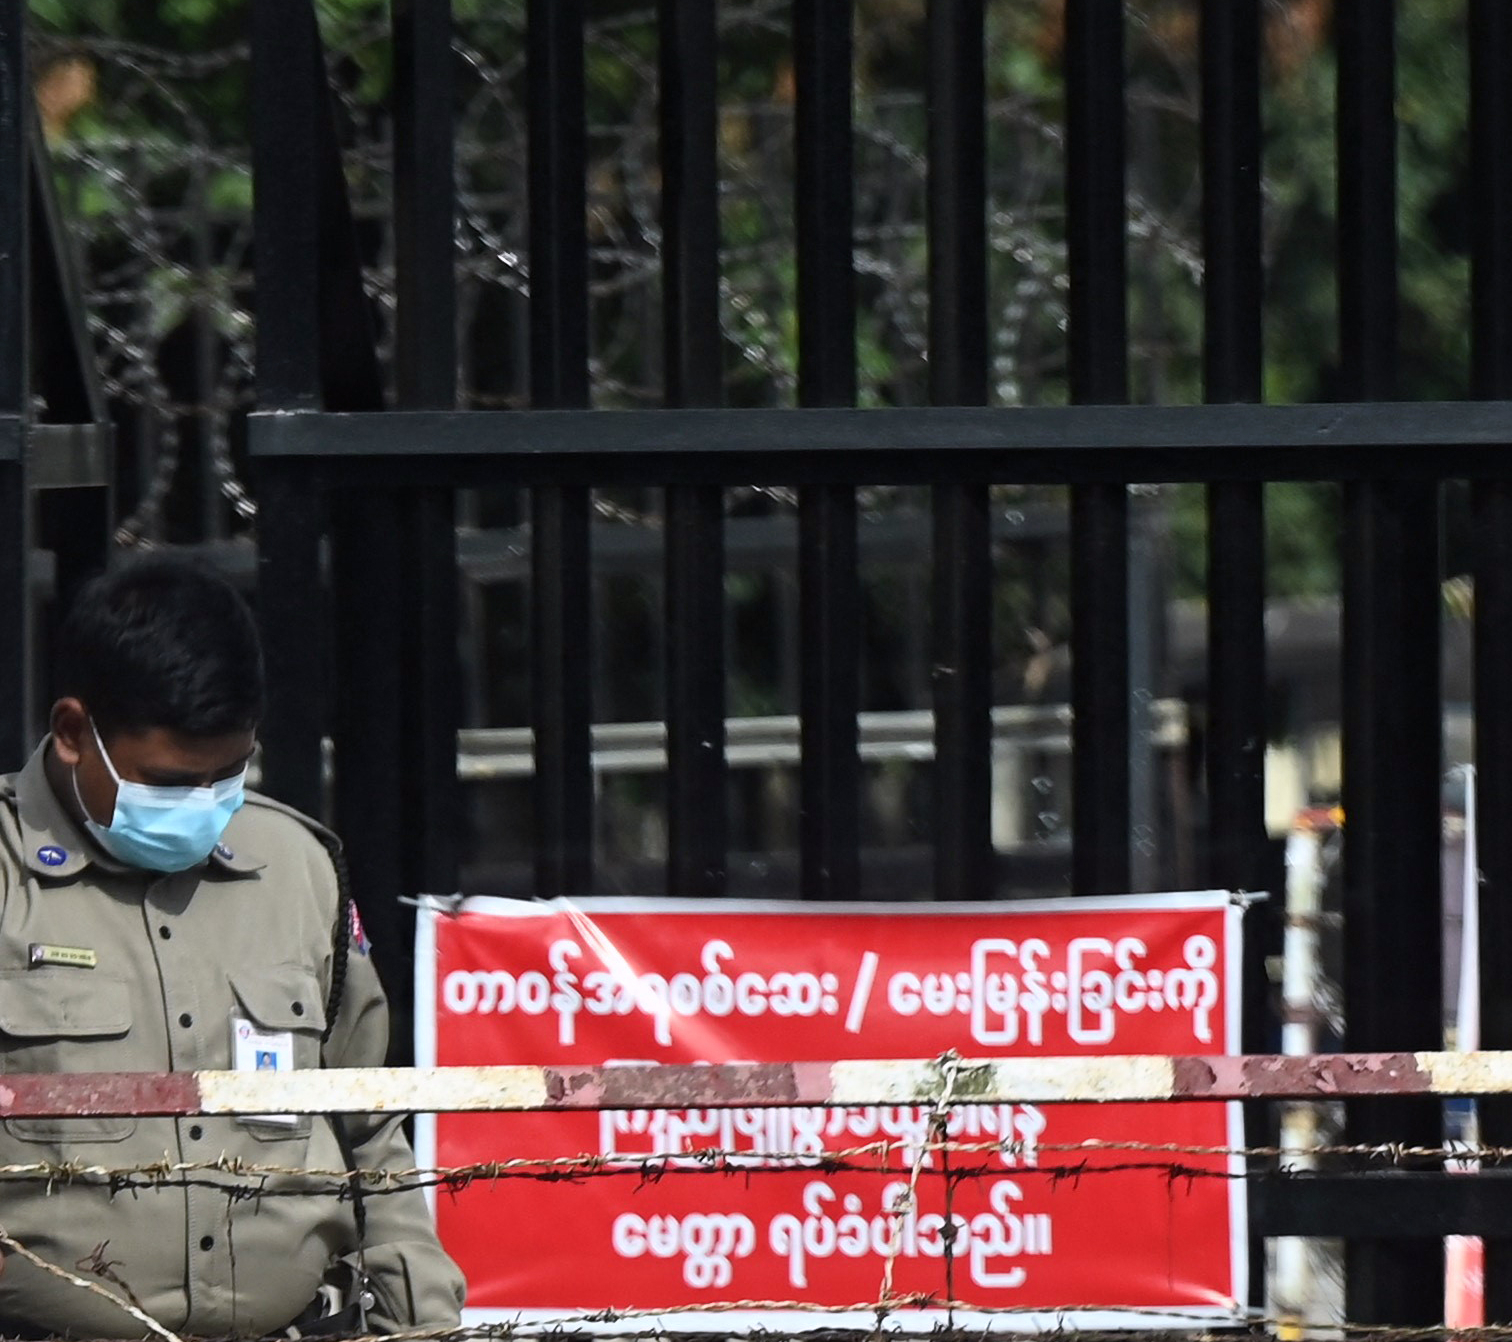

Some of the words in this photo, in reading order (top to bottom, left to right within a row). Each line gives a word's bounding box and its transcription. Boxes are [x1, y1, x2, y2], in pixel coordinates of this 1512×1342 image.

[844, 950, 878, 1034] /
[611, 1212, 756, 1289] မေတ္တာ
